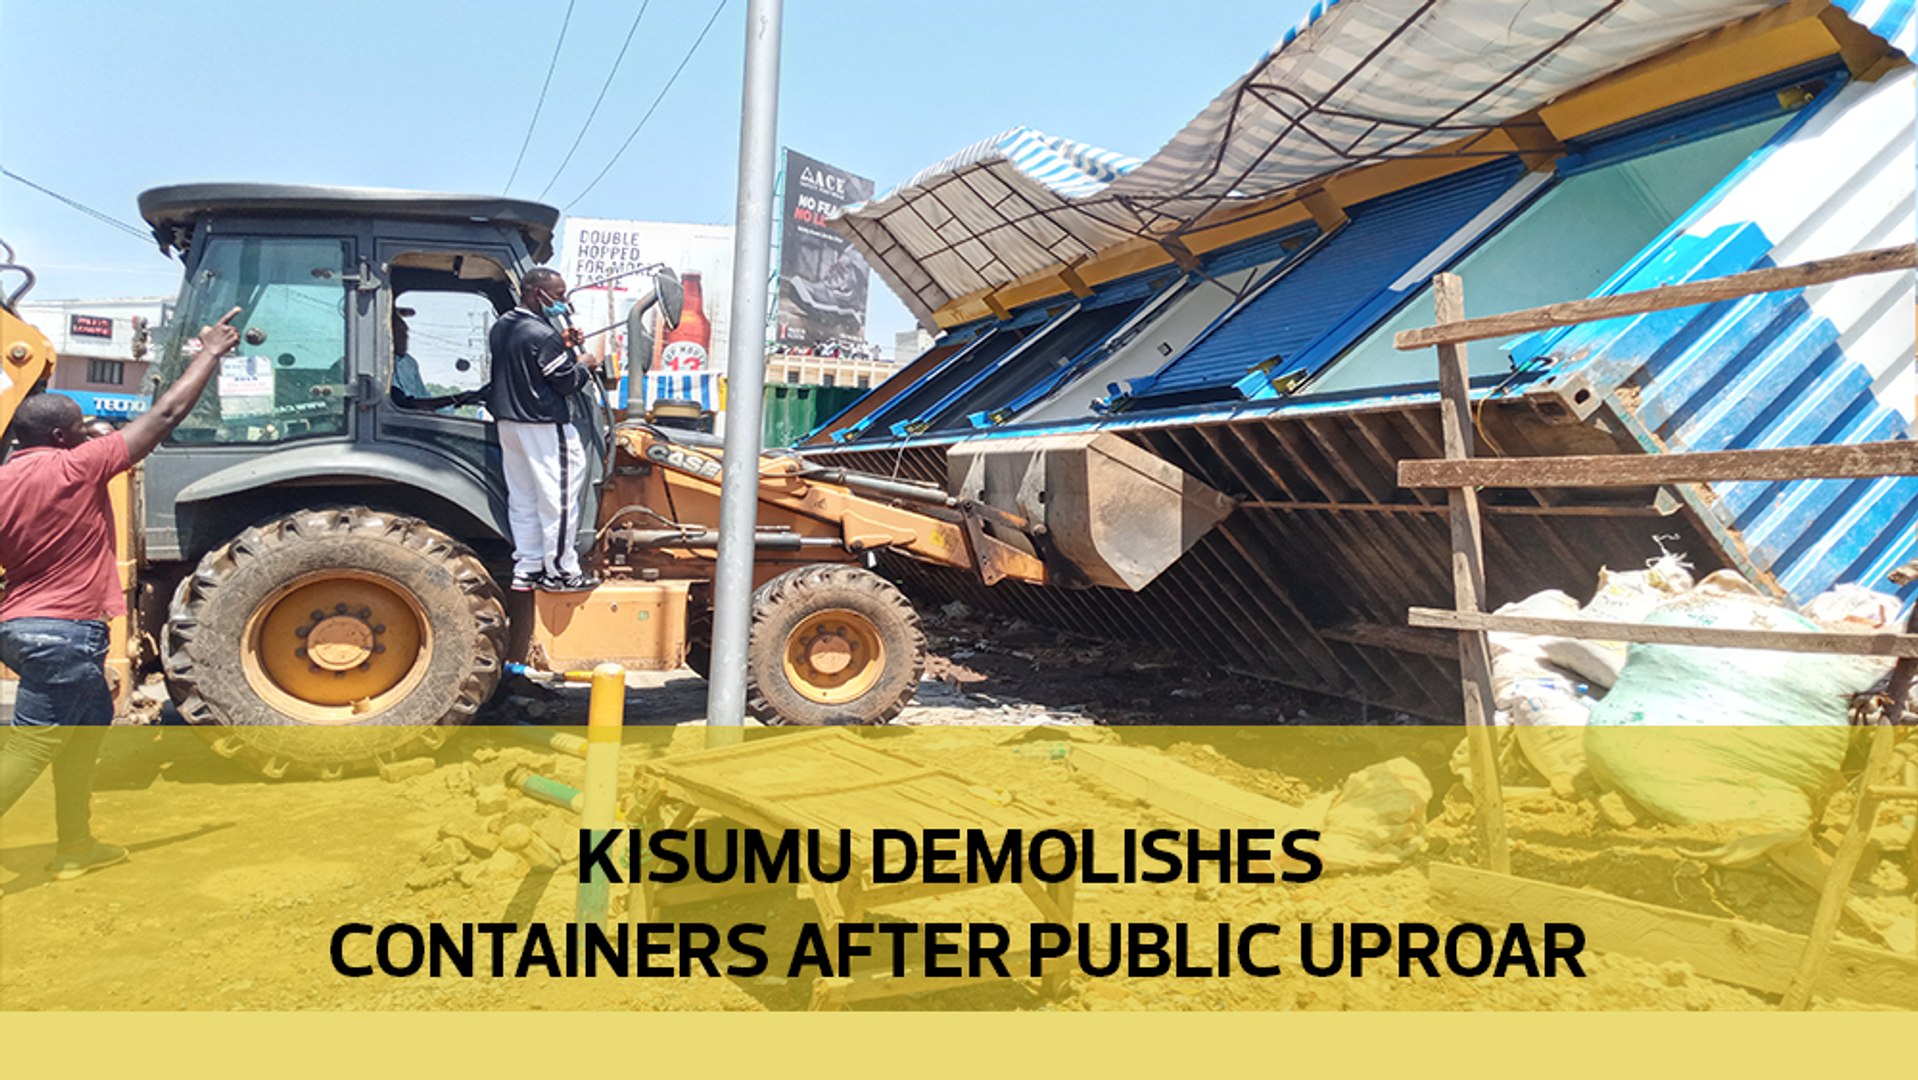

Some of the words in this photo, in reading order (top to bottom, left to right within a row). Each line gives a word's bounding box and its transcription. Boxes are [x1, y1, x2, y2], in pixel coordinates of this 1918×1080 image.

[815, 170, 847, 195] ACE
[798, 193, 816, 211] NO
[793, 206, 813, 224] NO
[579, 229, 640, 247] DOUBLE
[577, 244, 641, 261] HOPPED
[576, 258, 605, 274] FOR
[645, 443, 723, 478] CASE
